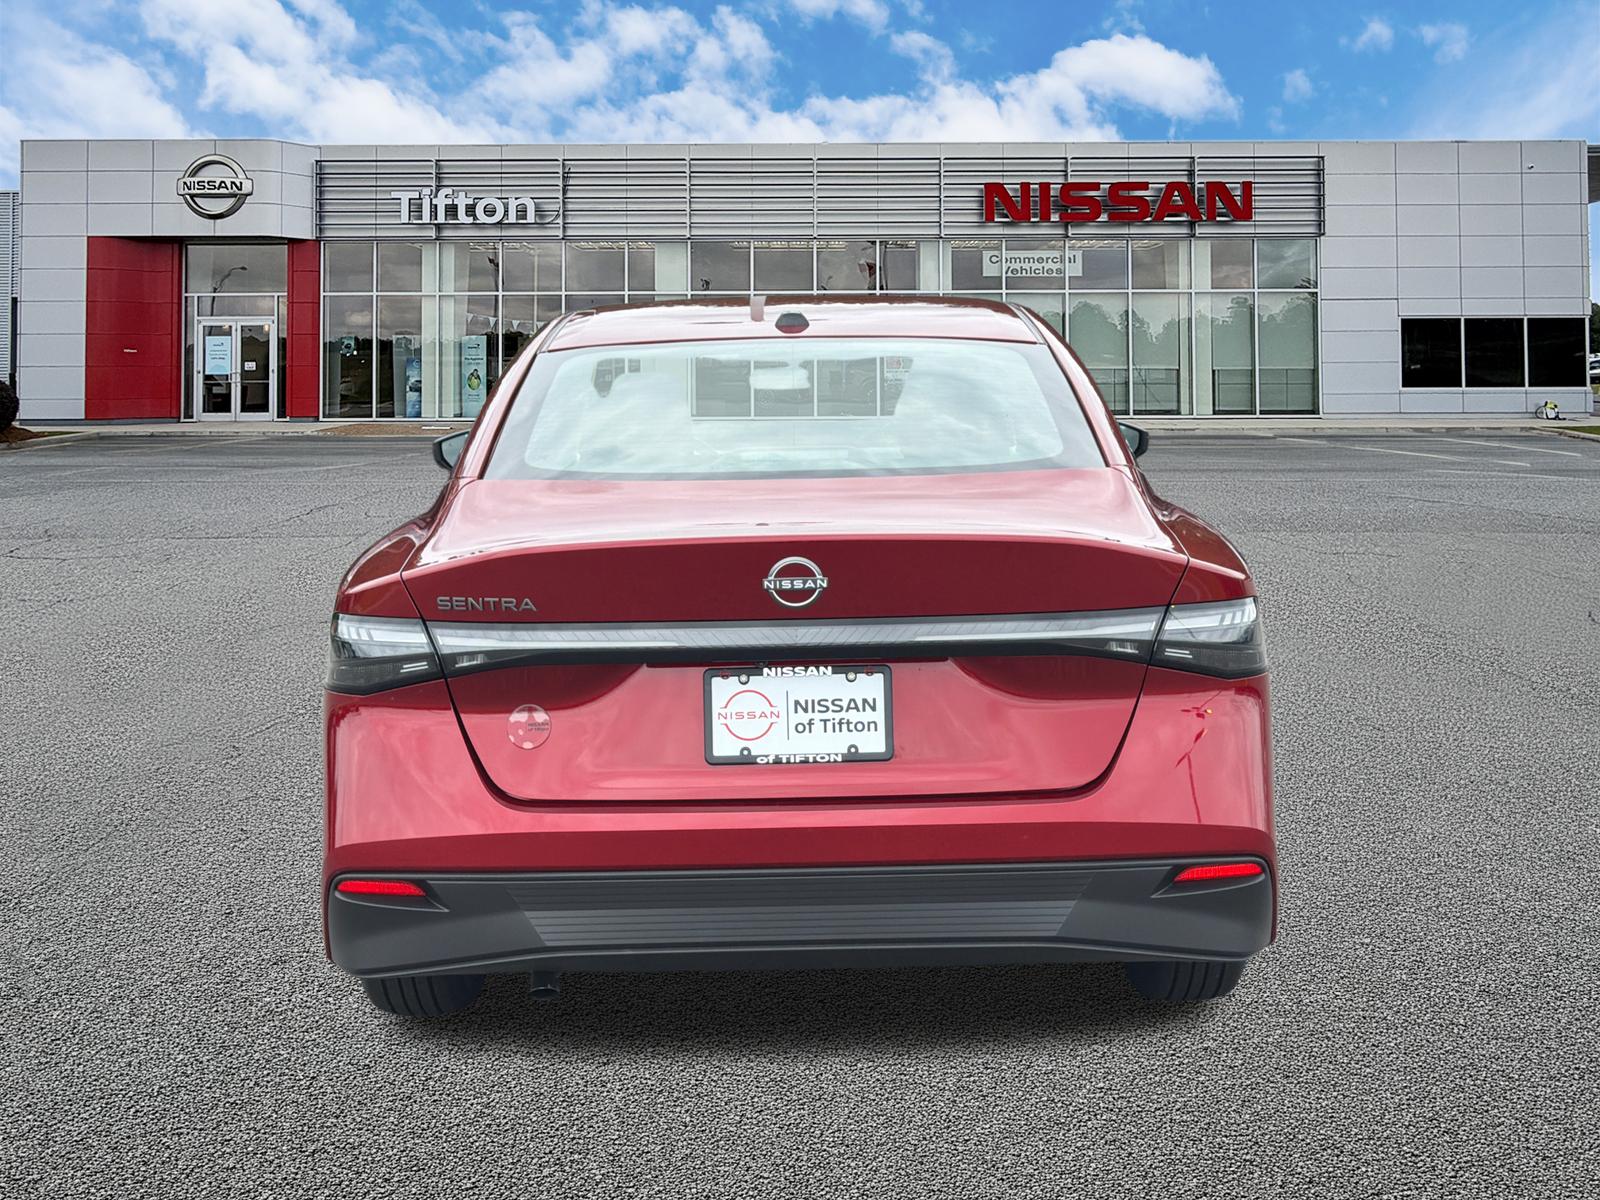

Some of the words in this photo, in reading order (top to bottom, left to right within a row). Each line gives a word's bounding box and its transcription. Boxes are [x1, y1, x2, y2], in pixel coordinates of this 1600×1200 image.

[182, 180, 243, 191] NISSAN
[391, 187, 536, 224] Tifton
[983, 180, 1253, 222] NISSAN
[764, 579, 827, 589] NISSAN
[436, 596, 537, 612] SENTRA
[762, 666, 832, 678] NISSAN
[793, 697, 877, 714] NISSAN
[717, 710, 780, 721] NISSAN
[794, 719, 815, 734] of
[819, 718, 878, 733] Tifton
[756, 753, 776, 764] of
[777, 753, 843, 764] TIFTON
